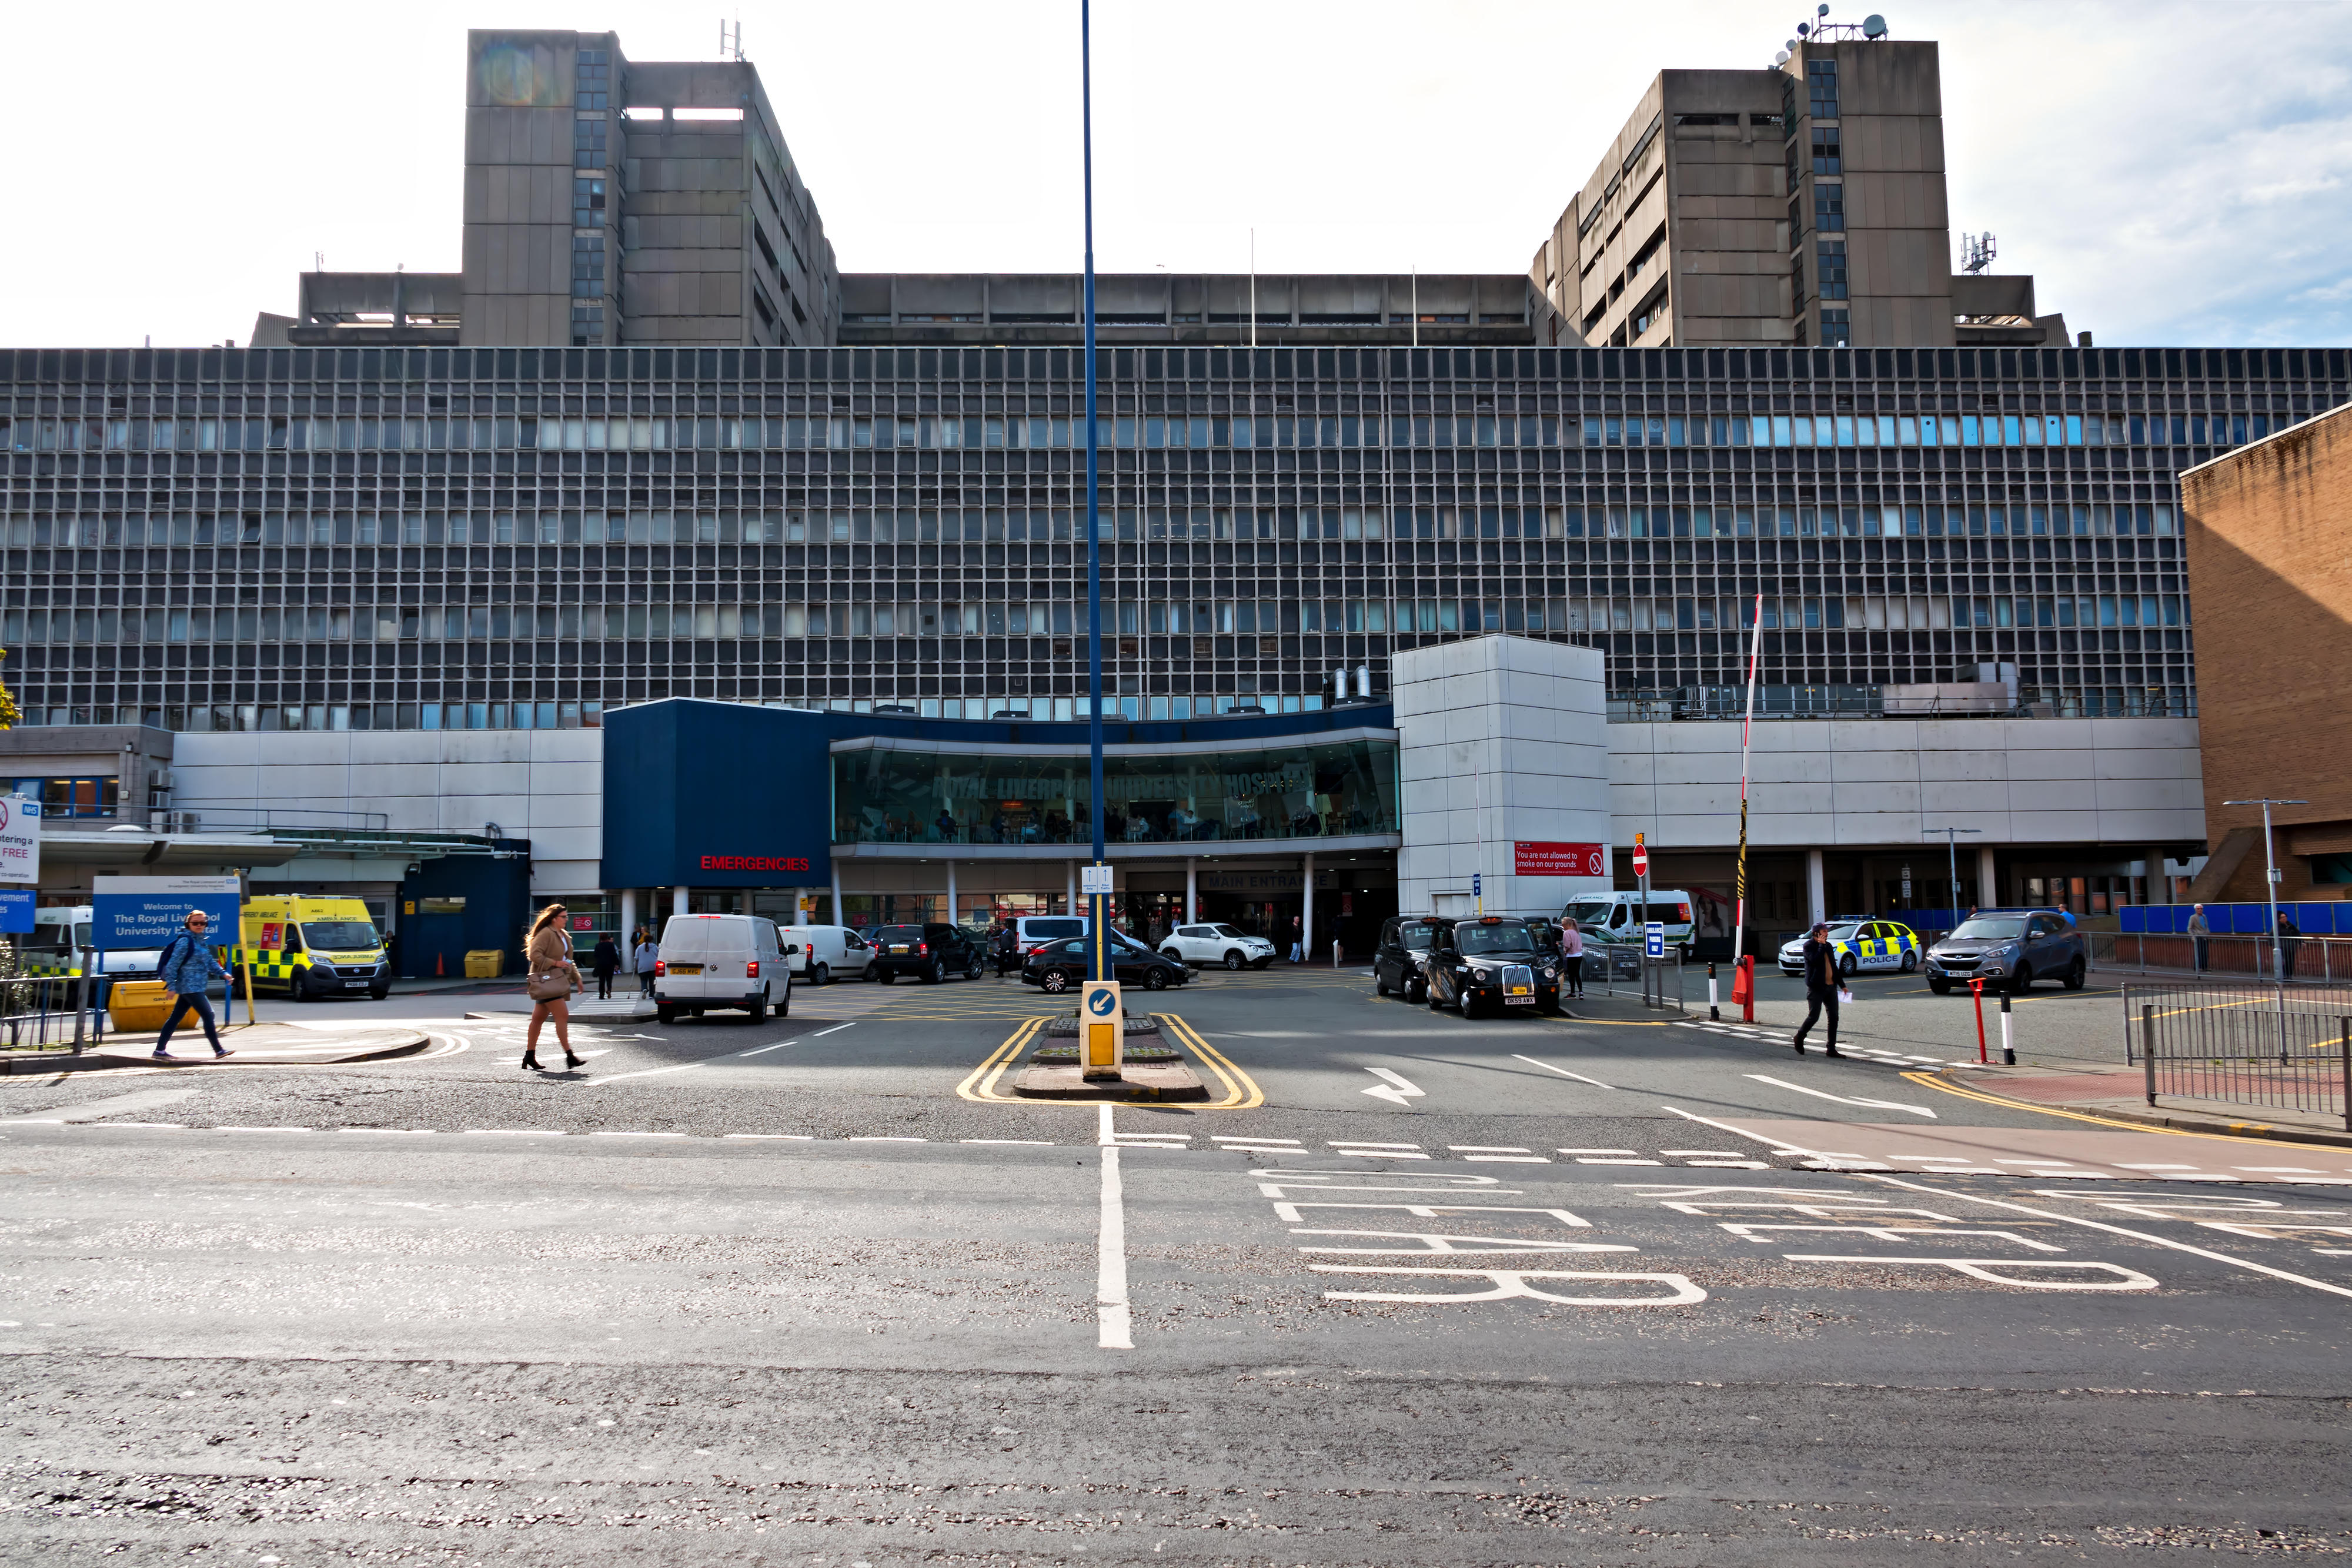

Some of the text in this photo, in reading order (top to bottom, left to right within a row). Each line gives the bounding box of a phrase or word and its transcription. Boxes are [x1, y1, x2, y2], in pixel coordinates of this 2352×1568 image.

[24, 805, 37, 814] NHS
[0, 835, 26, 846] tering
[2, 848, 28, 858] FREE
[700, 855, 809, 871] EMERGENCIES
[1555, 861, 1576, 869] grounds
[1208, 876, 1243, 887] MAIN
[114, 915, 135, 923] The
[138, 914, 168, 925] Royal
[116, 926, 171, 936] University
[1863, 955, 1899, 964] POLICE
